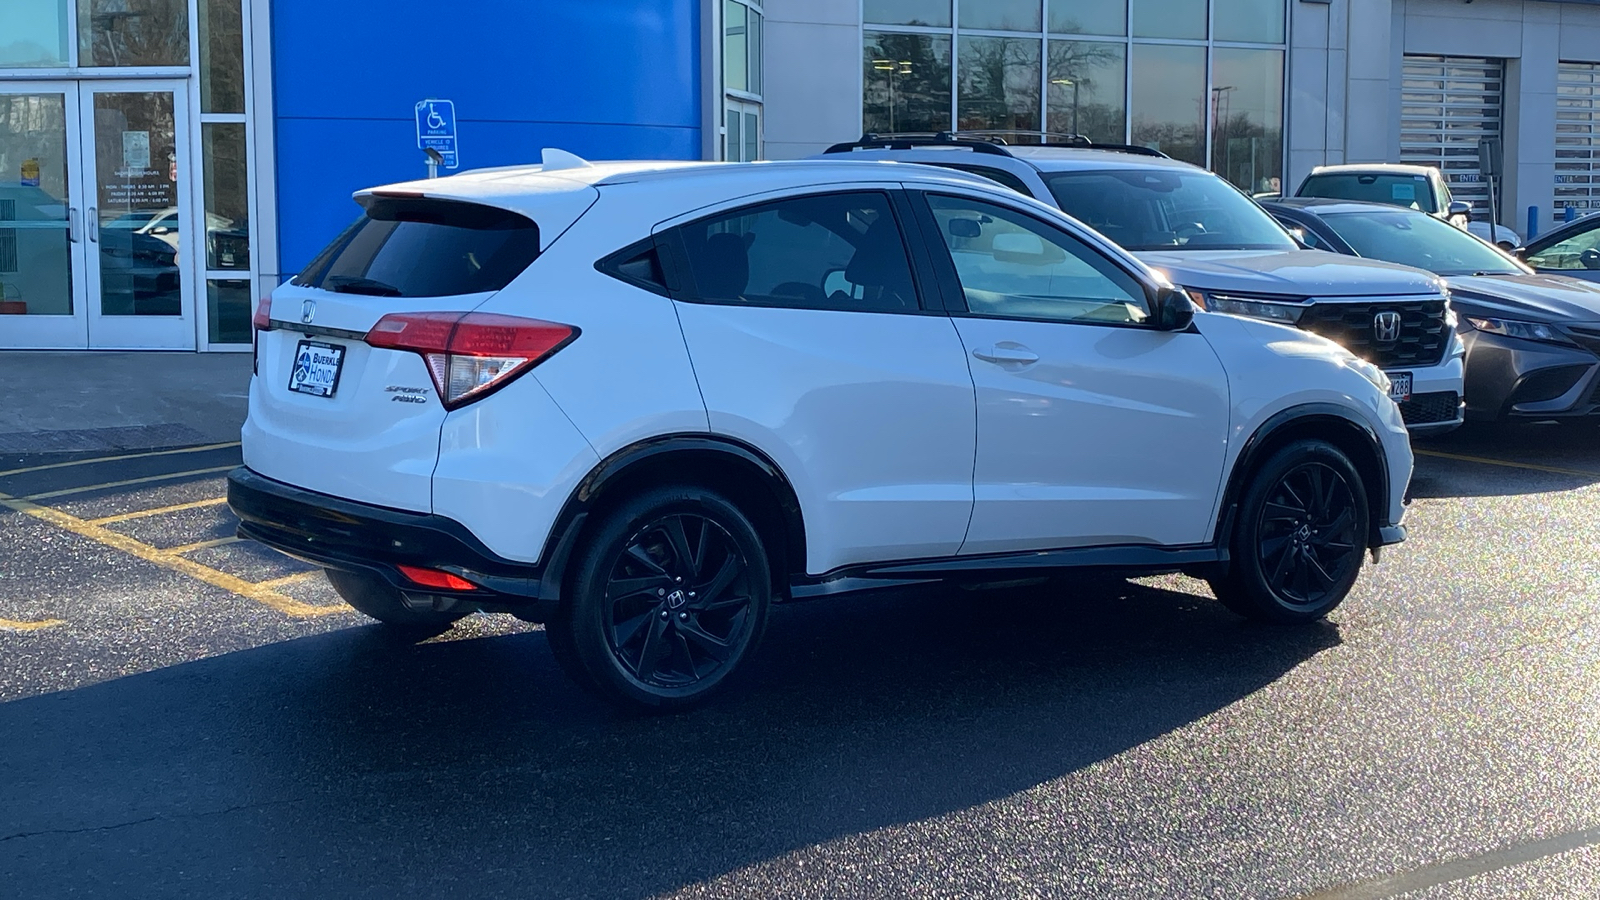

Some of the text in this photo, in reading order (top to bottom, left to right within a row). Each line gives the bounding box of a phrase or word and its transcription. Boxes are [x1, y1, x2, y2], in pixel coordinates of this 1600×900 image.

[1460, 174, 1480, 182] ENTER
[1555, 175, 1574, 183] ENTER
[313, 352, 340, 366] BUERKLE
[309, 364, 336, 384] HONDA
[391, 393, 427, 404] AWD
